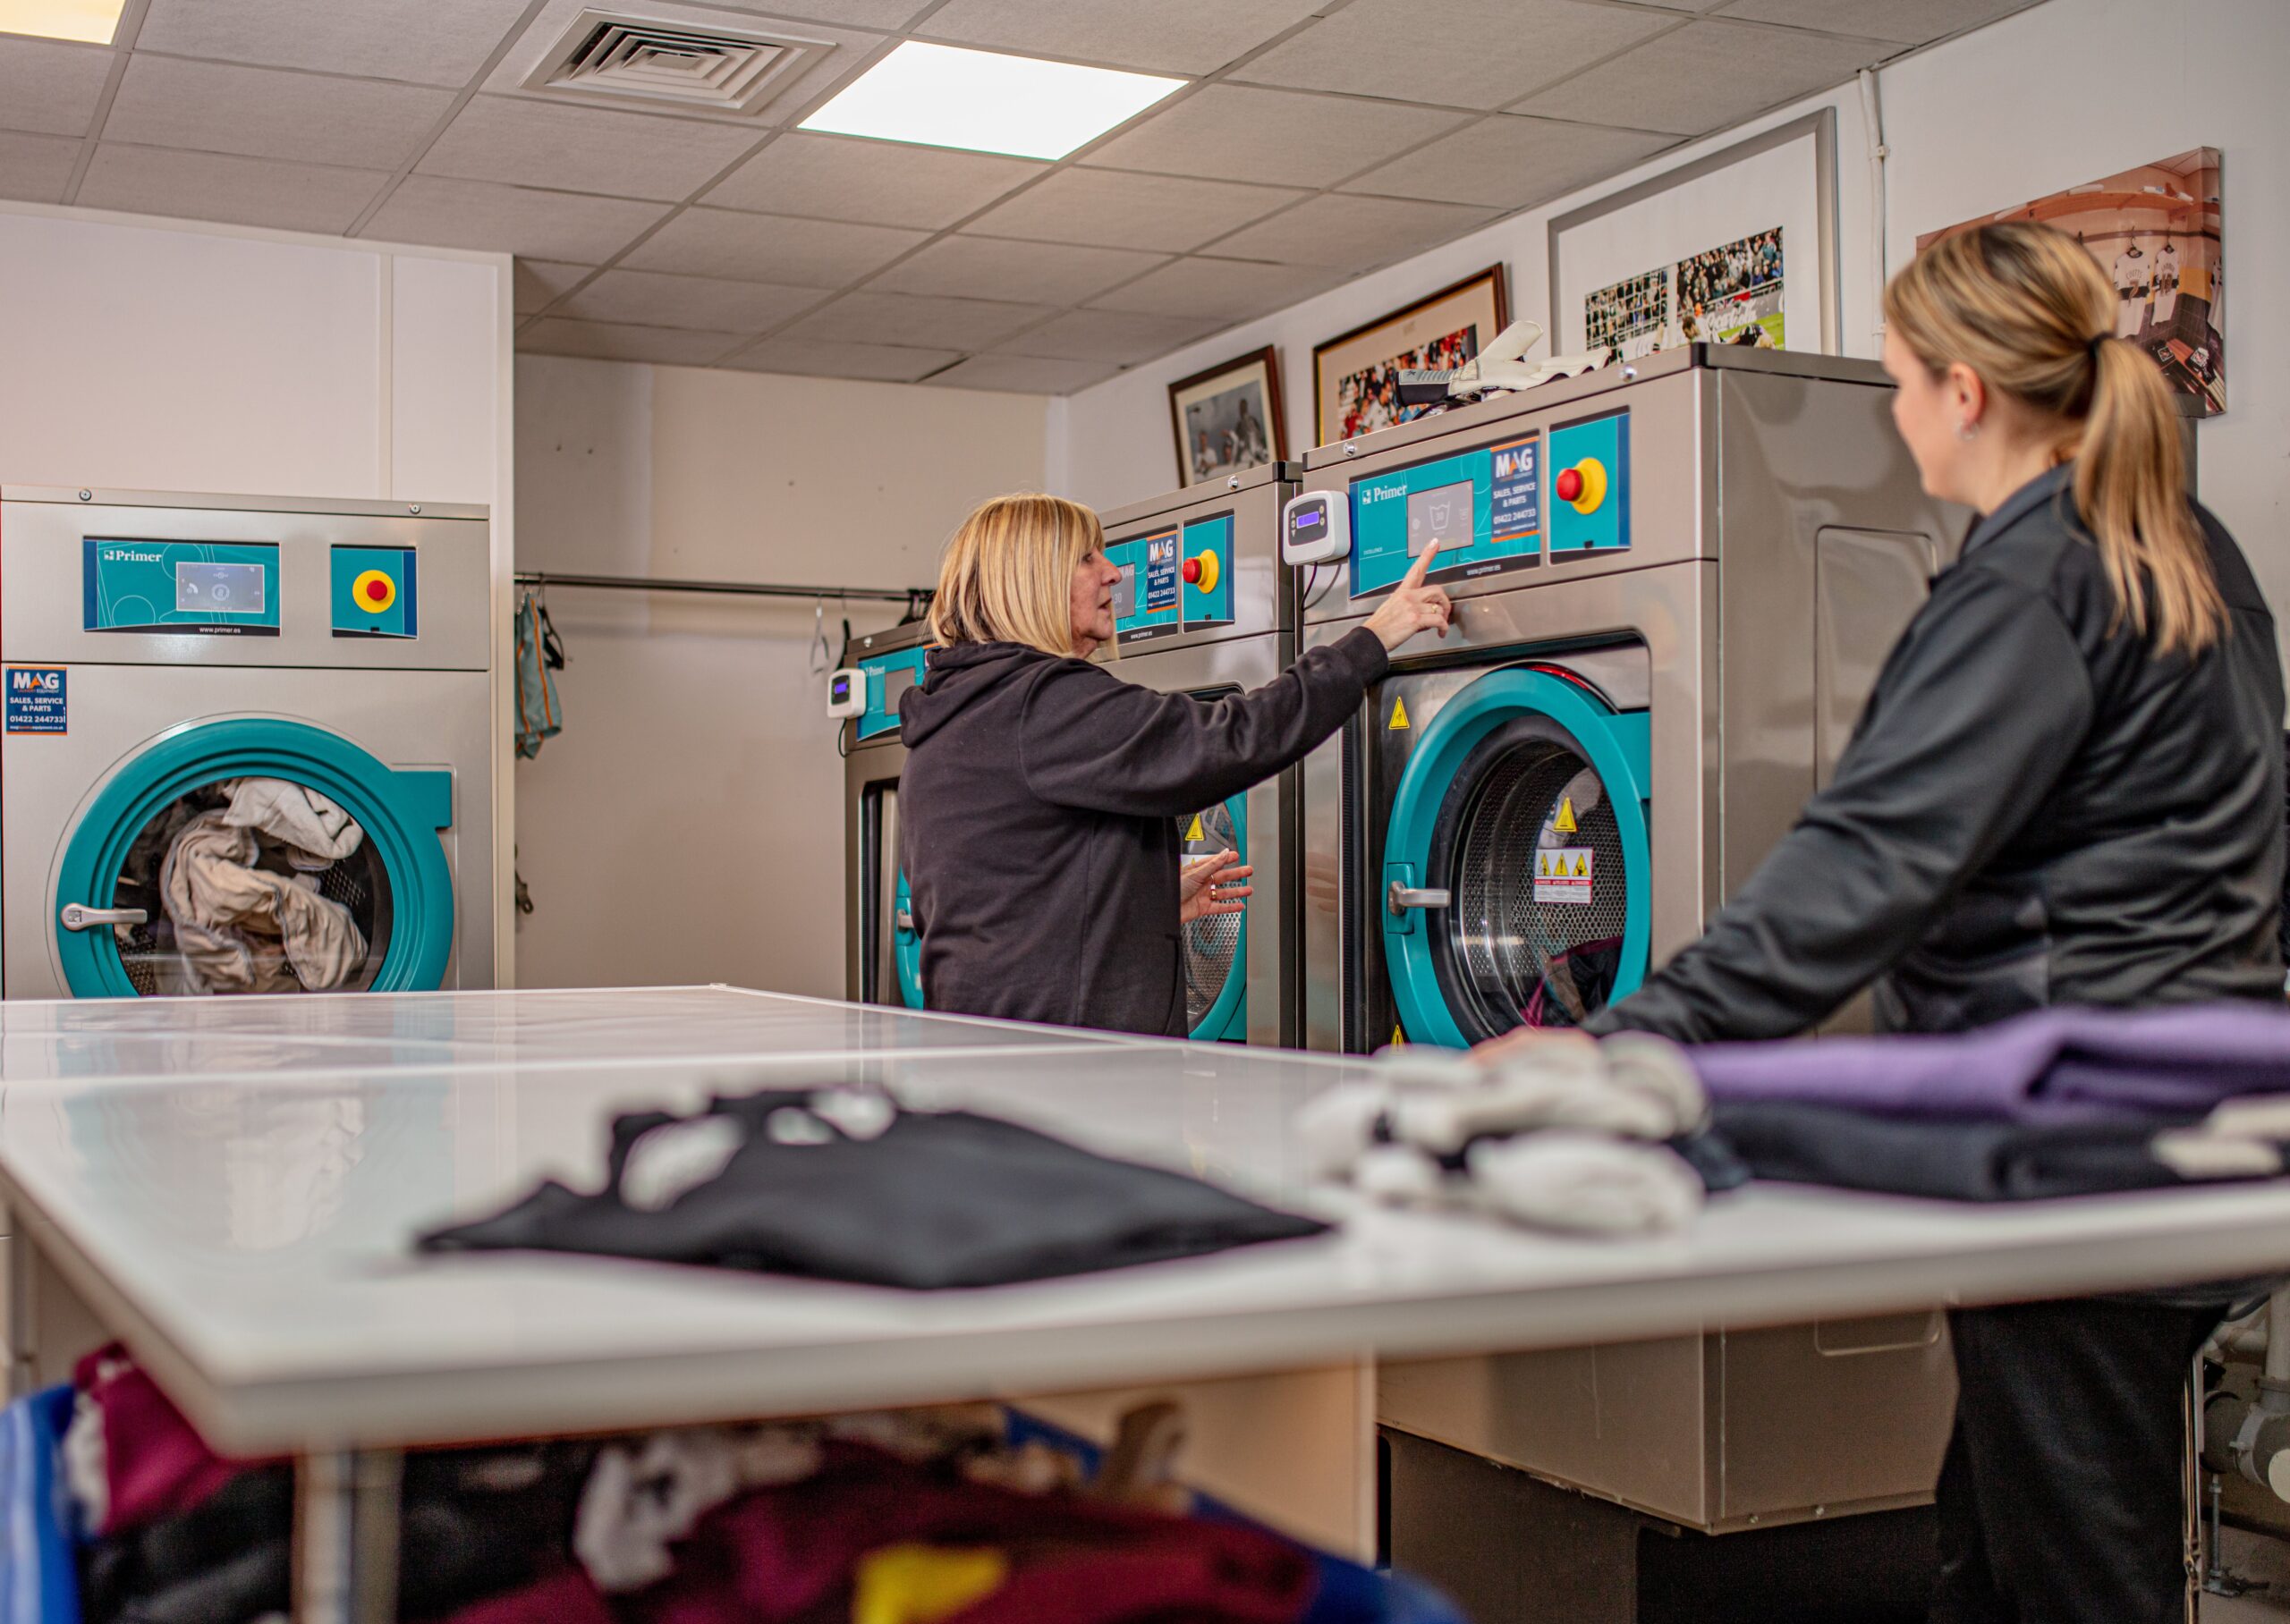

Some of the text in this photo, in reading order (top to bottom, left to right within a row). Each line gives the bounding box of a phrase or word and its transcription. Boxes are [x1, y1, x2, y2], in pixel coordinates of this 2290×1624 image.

[2128, 280, 2139, 307] 7
[1496, 448, 1533, 478] MAG
[1374, 484, 1408, 502] Primer
[115, 550, 162, 562] Primer
[1149, 539, 1173, 562] MAG
[199, 627, 242, 635] www.primer.es
[13, 672, 60, 689] MAG
[10, 697, 33, 705] SALES,
[34, 715, 64, 723] 244733
